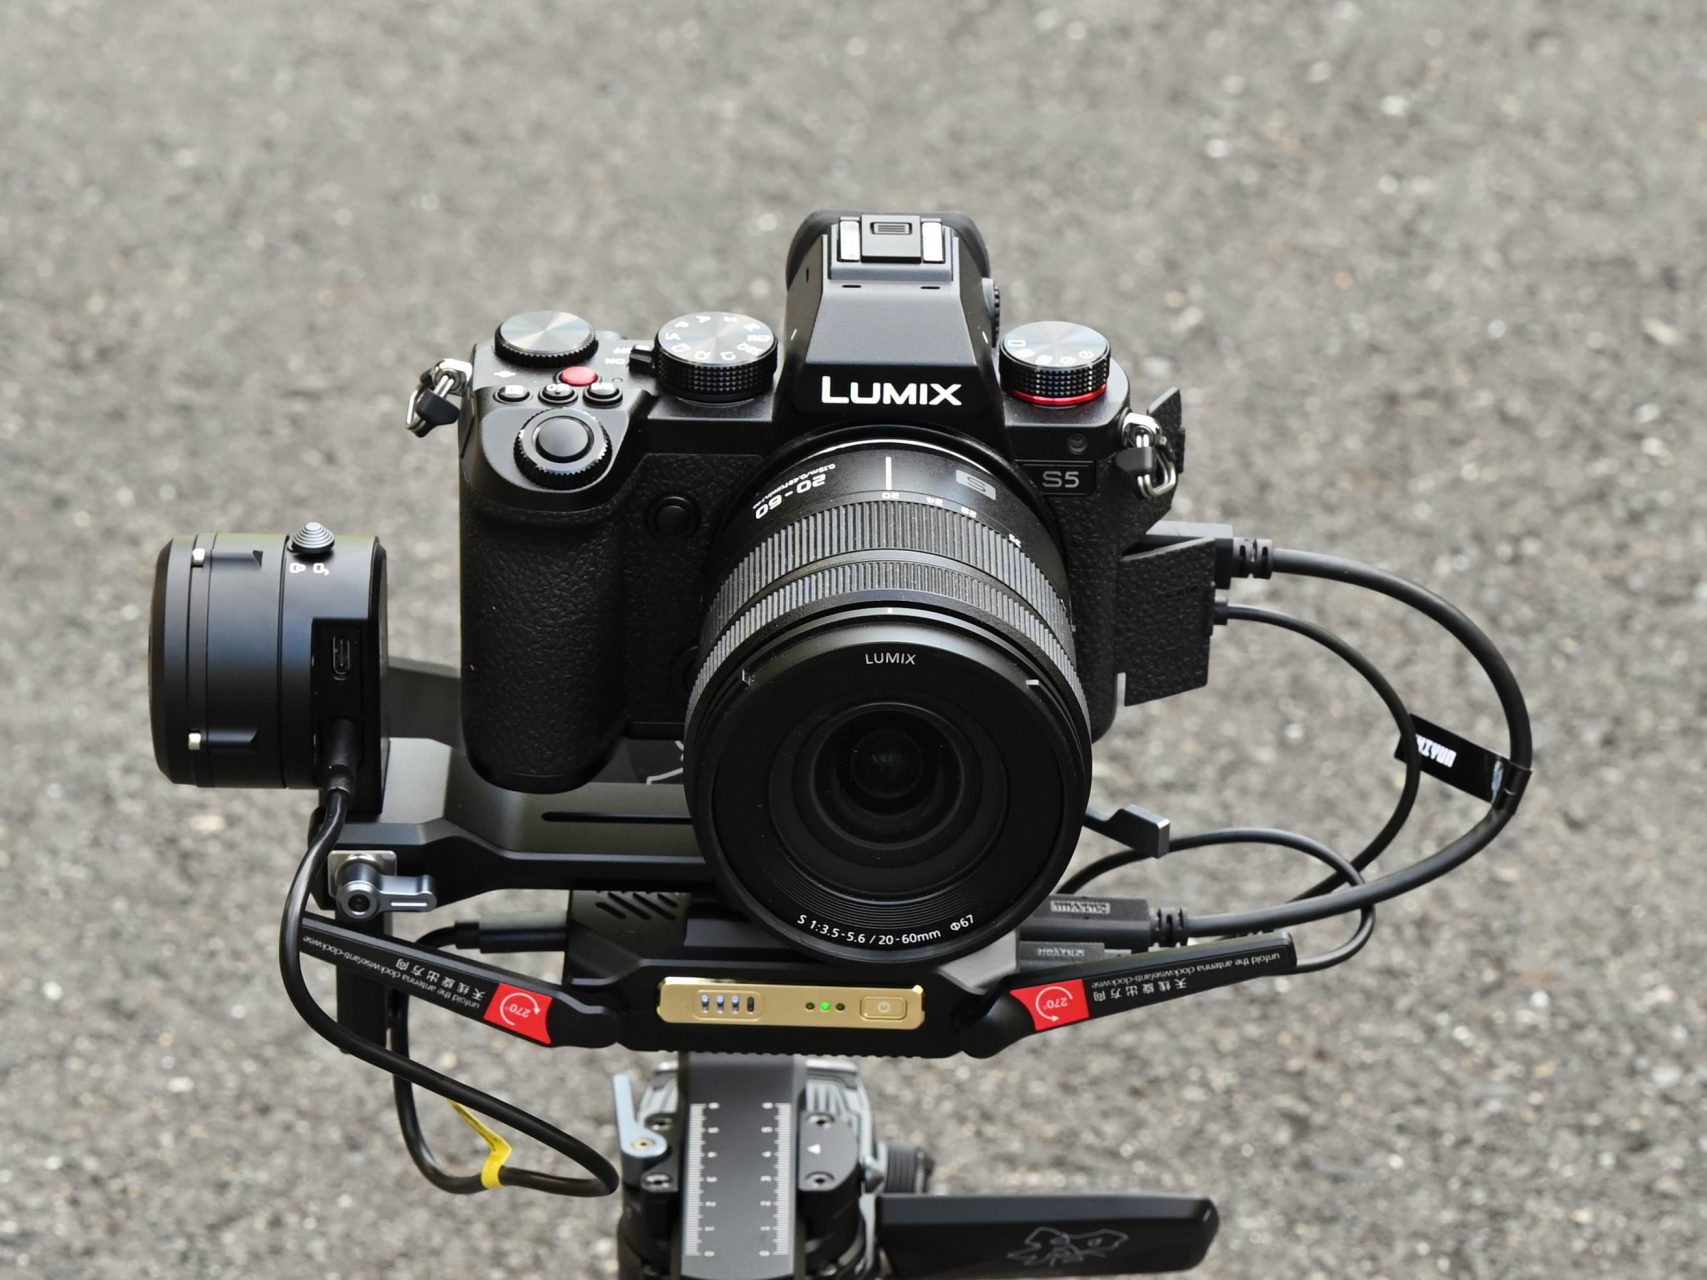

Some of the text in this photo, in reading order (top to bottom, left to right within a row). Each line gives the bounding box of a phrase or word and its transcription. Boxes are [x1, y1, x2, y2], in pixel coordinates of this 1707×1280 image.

[821, 375, 962, 406] LUMIX
[1042, 470, 1080, 489] S5
[881, 491, 900, 500] 20
[865, 652, 917, 665] LUMIX
[797, 914, 807, 925] S
[810, 920, 866, 944] 1:3.5-5.6
[878, 929, 942, 946] 20-60mm
[1197, 959, 1234, 973] antenna
[1235, 956, 1250, 967] the
[1251, 952, 1281, 967] unfold
[402, 974, 437, 992] antenna
[437, 987, 451, 1000] the
[450, 993, 480, 1009] unfold
